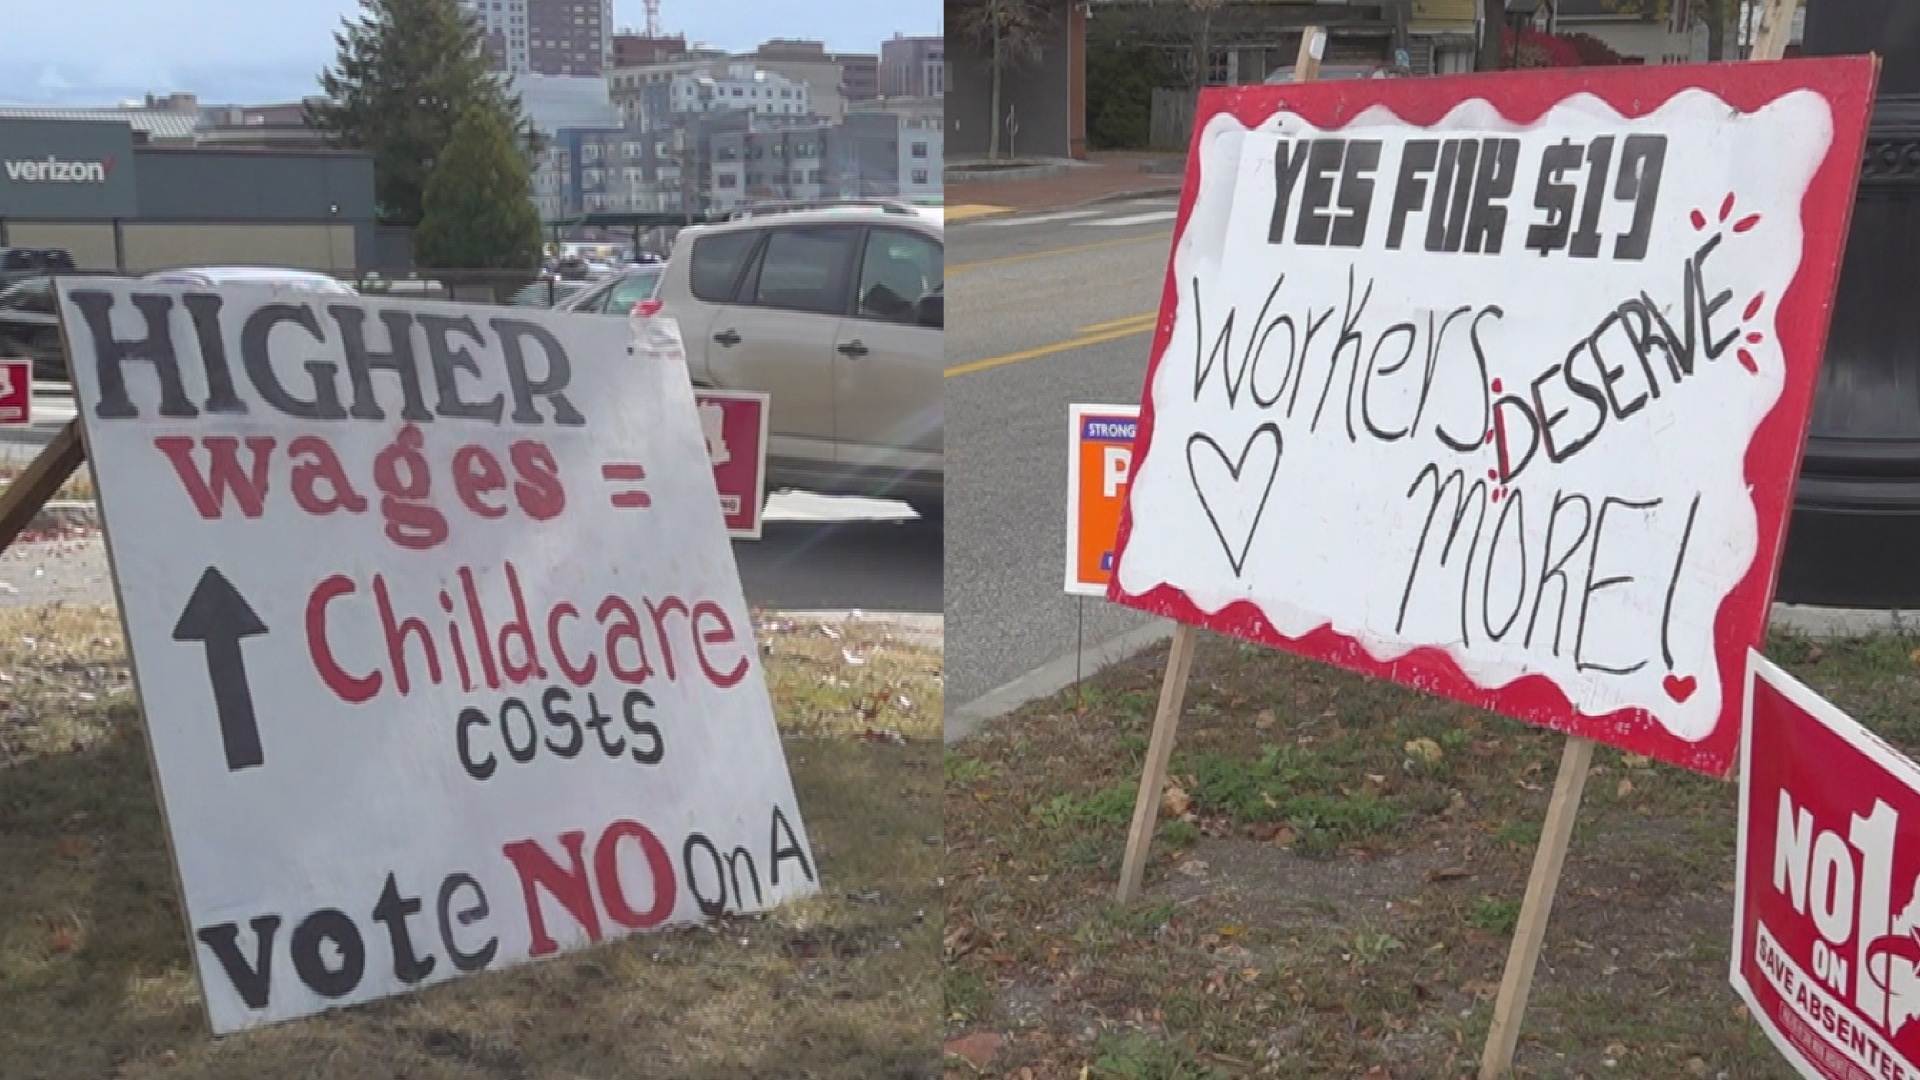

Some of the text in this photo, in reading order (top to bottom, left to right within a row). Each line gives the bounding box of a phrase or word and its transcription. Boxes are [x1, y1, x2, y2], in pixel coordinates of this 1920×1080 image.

[4, 154, 105, 181] verizon
[1267, 134, 1667, 259] YES FOR $19
[69, 292, 586, 425] HIGHER
[1493, 233, 1741, 484] DESERVE
[1089, 423, 1136, 438] STRONG
[305, 561, 749, 702] Childcare
[456, 687, 664, 779] costs
[503, 819, 677, 957] NO
[770, 805, 814, 884] A
[1758, 934, 1794, 995] SAVE
[1812, 939, 1849, 998] ON
